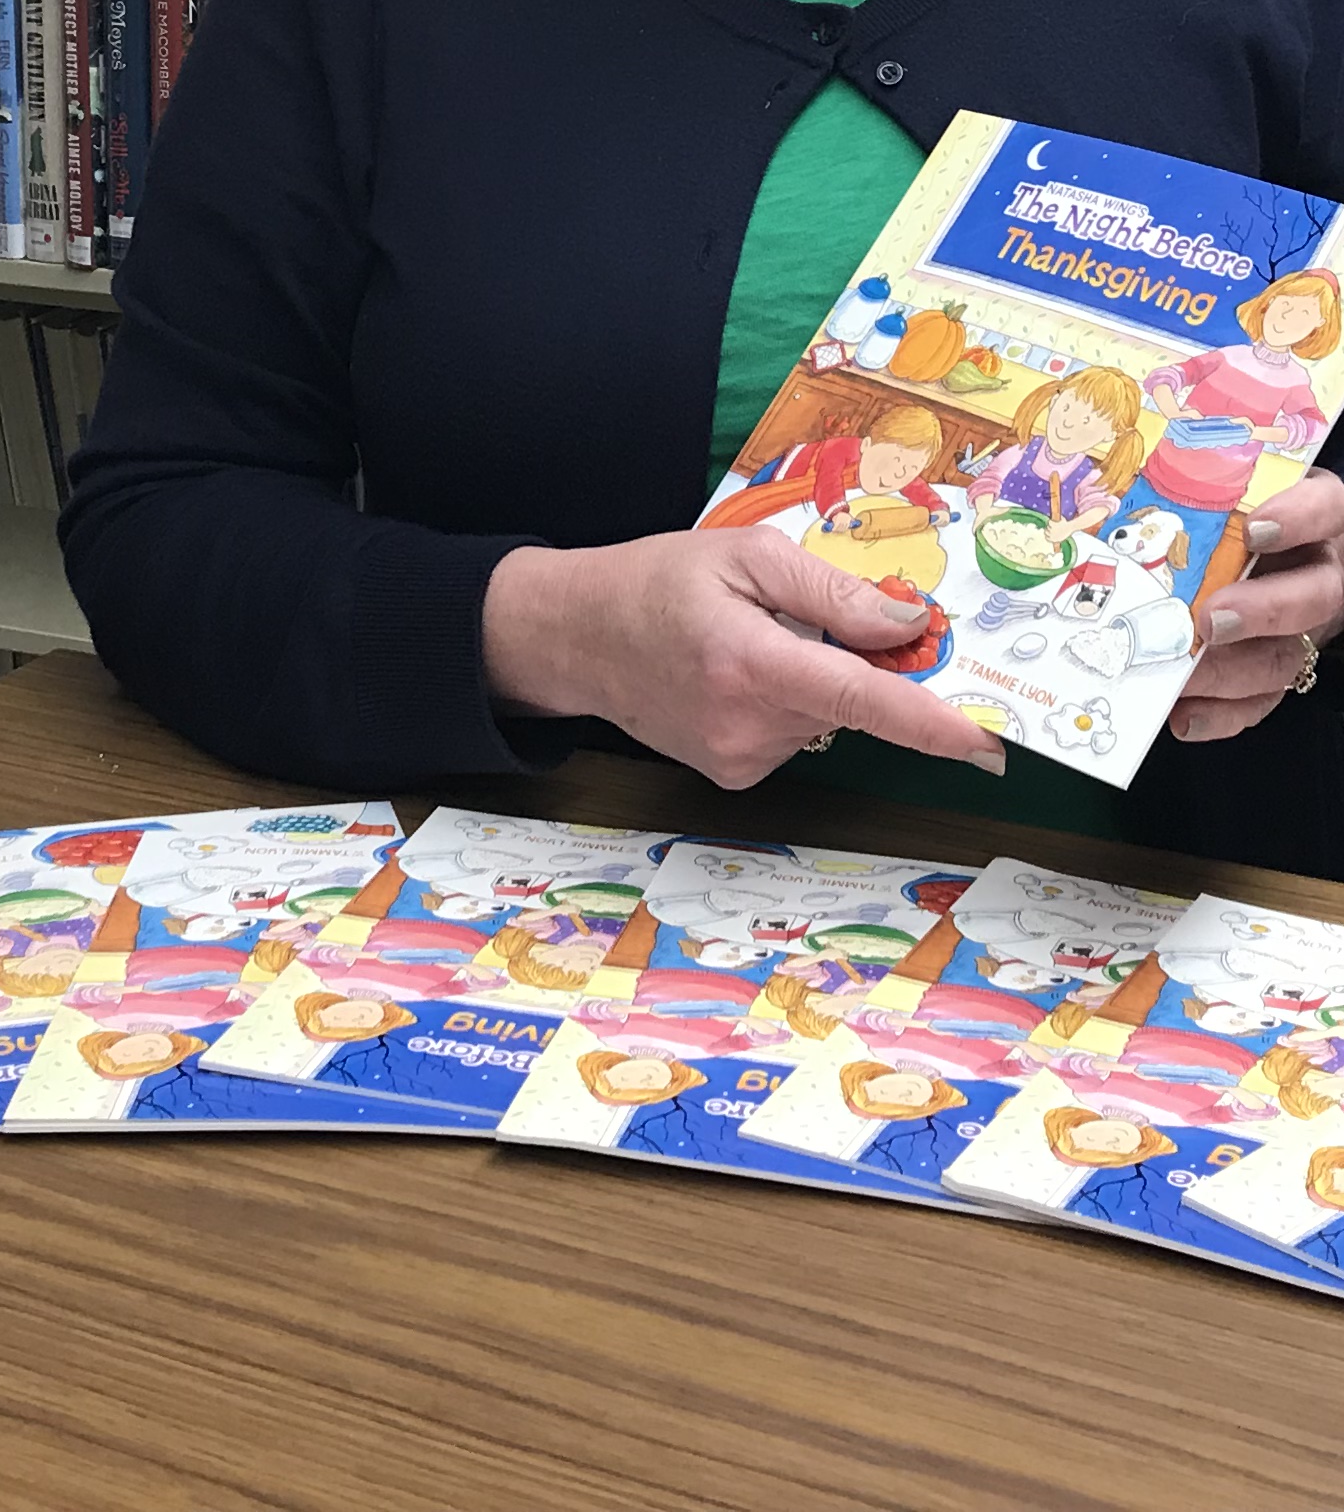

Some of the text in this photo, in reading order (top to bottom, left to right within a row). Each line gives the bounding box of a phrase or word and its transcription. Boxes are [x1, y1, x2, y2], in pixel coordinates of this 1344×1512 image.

[65, 42, 78, 96] MOTHER
[109, 2, 127, 72] Moyes
[158, 14, 170, 99] MACOMBER
[26, 32, 46, 123] GENTLEMEN
[1007, 184, 1251, 277] The Night Before
[1046, 184, 1148, 218] NATASHA WING'S
[997, 226, 1218, 326] Thanksgiving
[969, 660, 1058, 708] TAMMIE LYON
